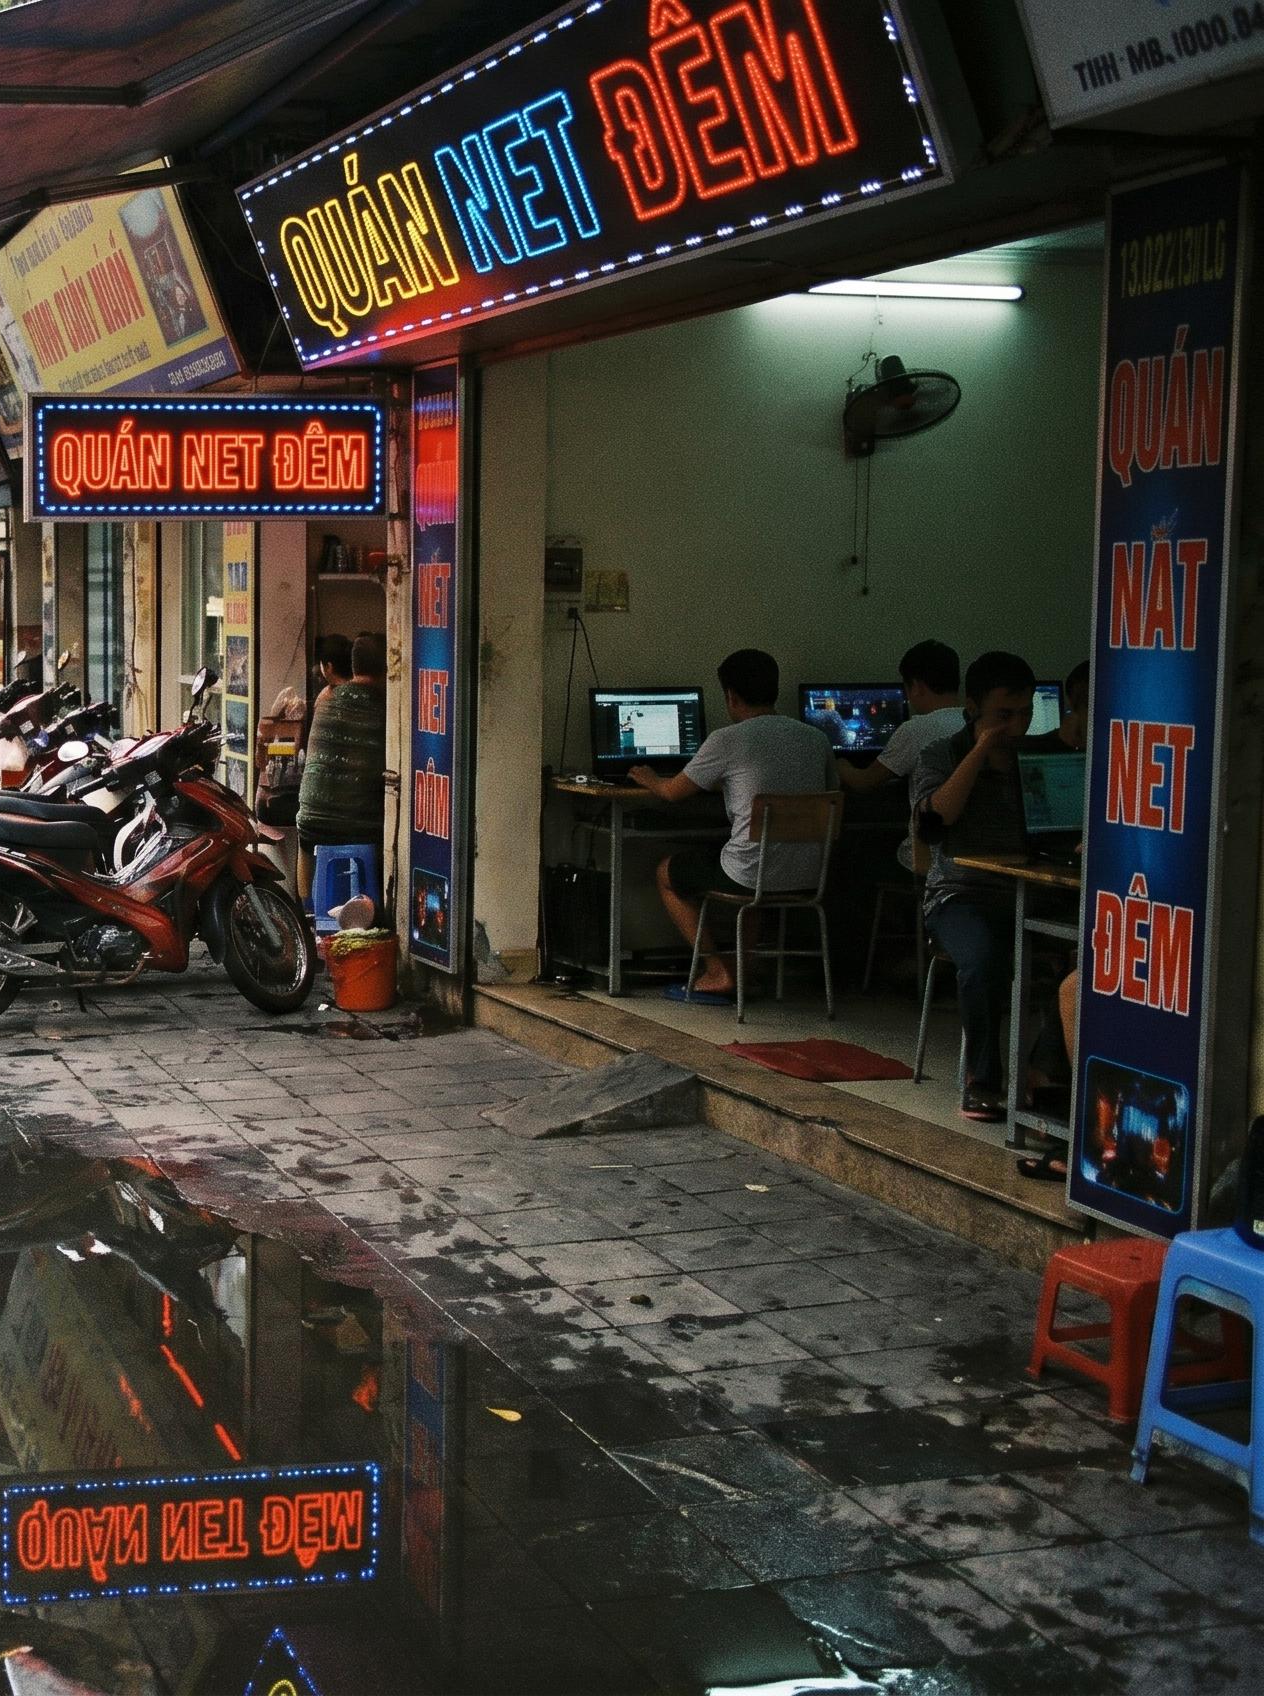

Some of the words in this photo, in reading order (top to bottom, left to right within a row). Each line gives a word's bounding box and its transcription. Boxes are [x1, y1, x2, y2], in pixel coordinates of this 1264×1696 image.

[280, 152, 459, 338] QUÁN
[434, 91, 602, 274] NET
[588, 0, 858, 222] ĐÊM
[52, 420, 171, 497] QUÁN
[182, 434, 264, 490] NET
[272, 421, 366, 490] ĐÊM
[1108, 323, 1226, 489] QUÁN
[418, 667, 450, 736] NET
[1105, 718, 1196, 834] NET
[1091, 871, 1195, 1018] ĐÊM
